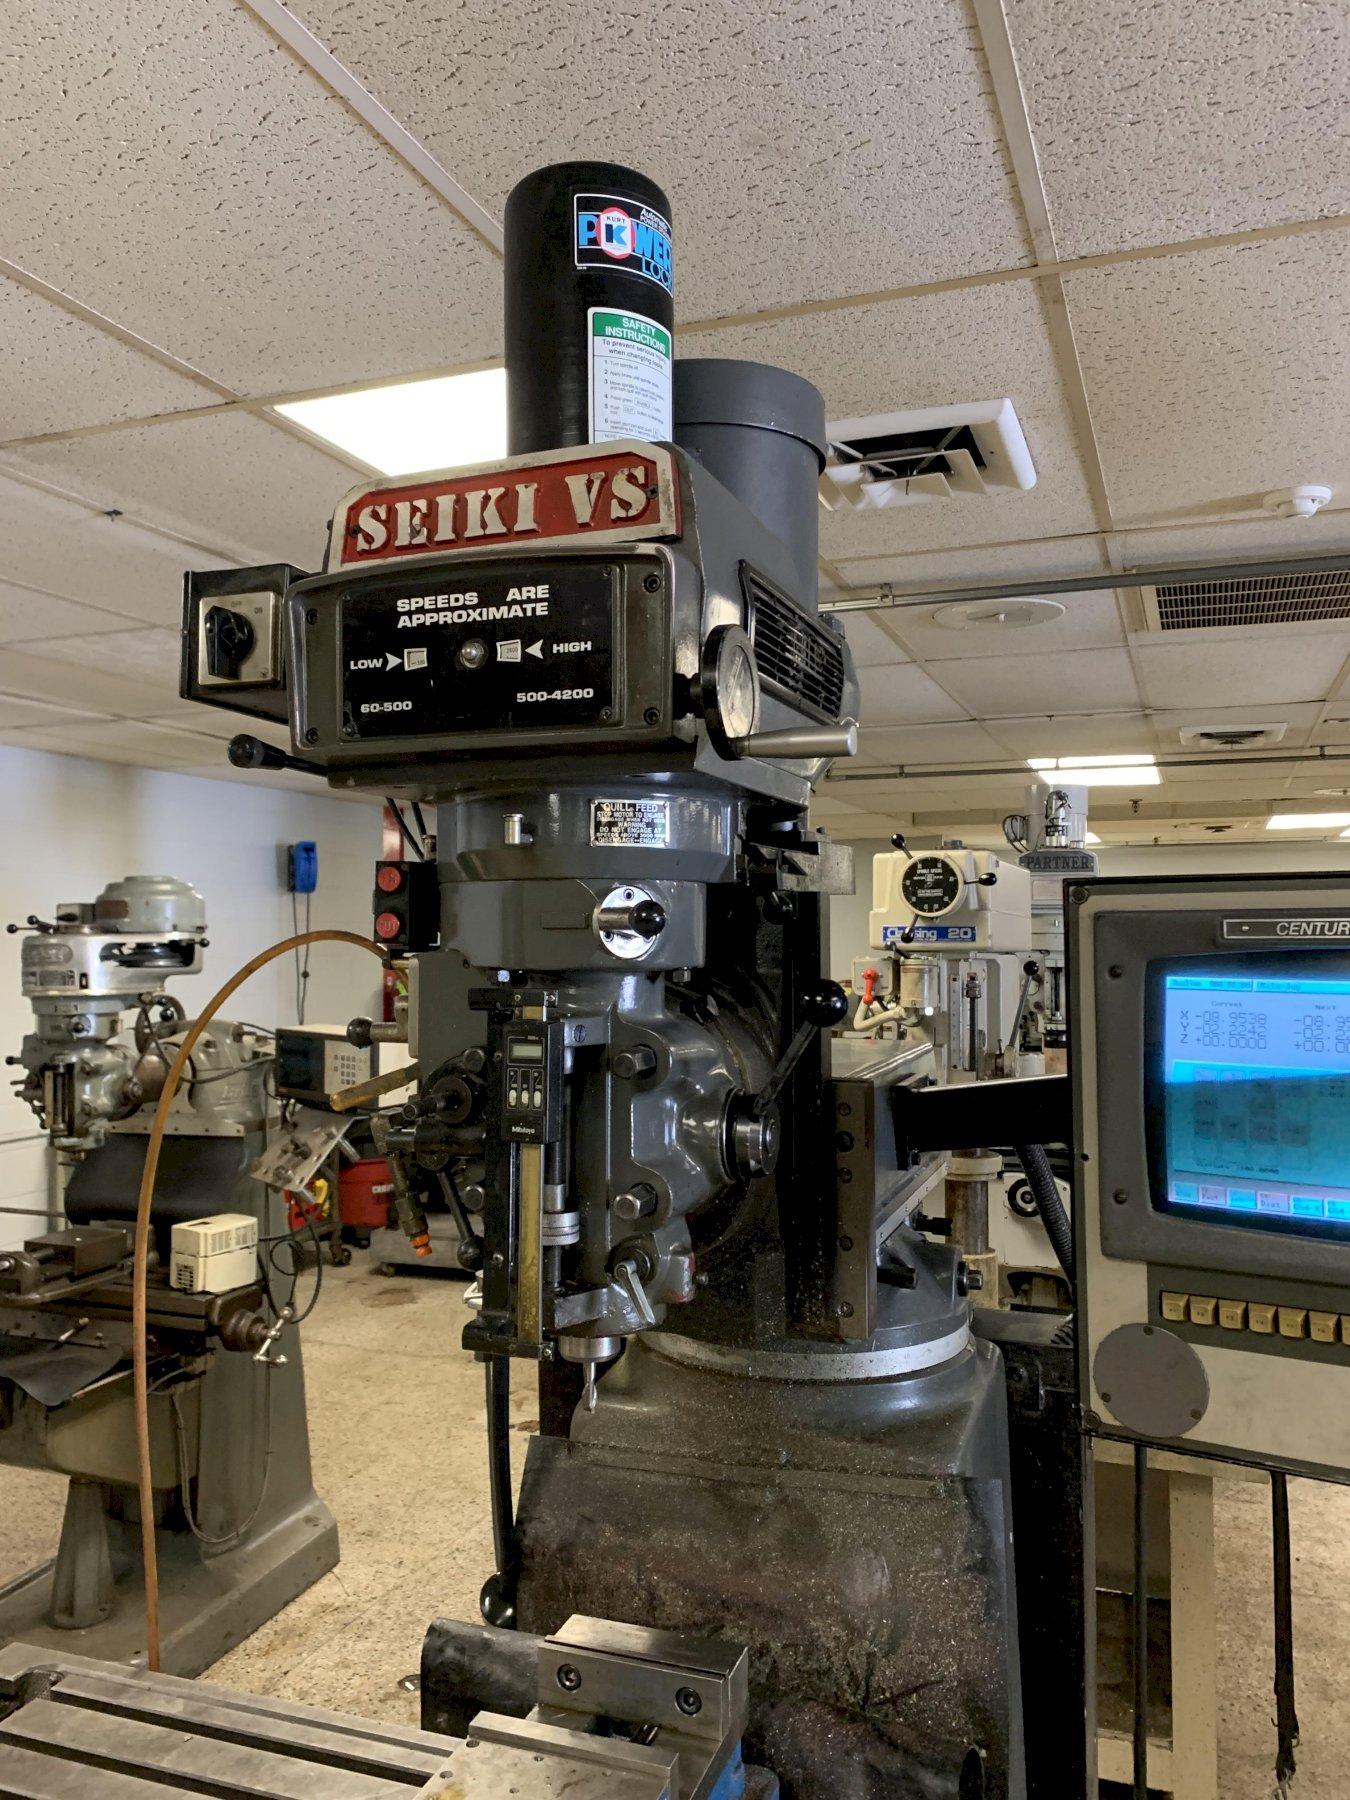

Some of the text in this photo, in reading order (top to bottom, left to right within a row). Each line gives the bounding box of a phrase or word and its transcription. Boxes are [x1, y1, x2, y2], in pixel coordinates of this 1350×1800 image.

[606, 215, 626, 224] KURT
[622, 317, 656, 336] SAFETY
[605, 326, 666, 354] INSTRUCTIONS
[612, 339, 635, 350] prevent
[357, 465, 648, 552] SEIKI VS
[397, 585, 550, 612] SPEEDS ARE
[397, 602, 549, 628] APPROXIMATE
[552, 641, 593, 654] HIGH
[350, 658, 384, 670] LOW
[516, 688, 595, 703] 500-4200
[360, 700, 413, 714] 60-500
[602, 802, 659, 813] QUILL FEED
[1026, 855, 1090, 870] PARTNER
[948, 927, 972, 939] 20
[1180, 1010, 1189, 1021] X
[1180, 1022, 1190, 1032] Y
[1180, 1034, 1189, 1044] Z
